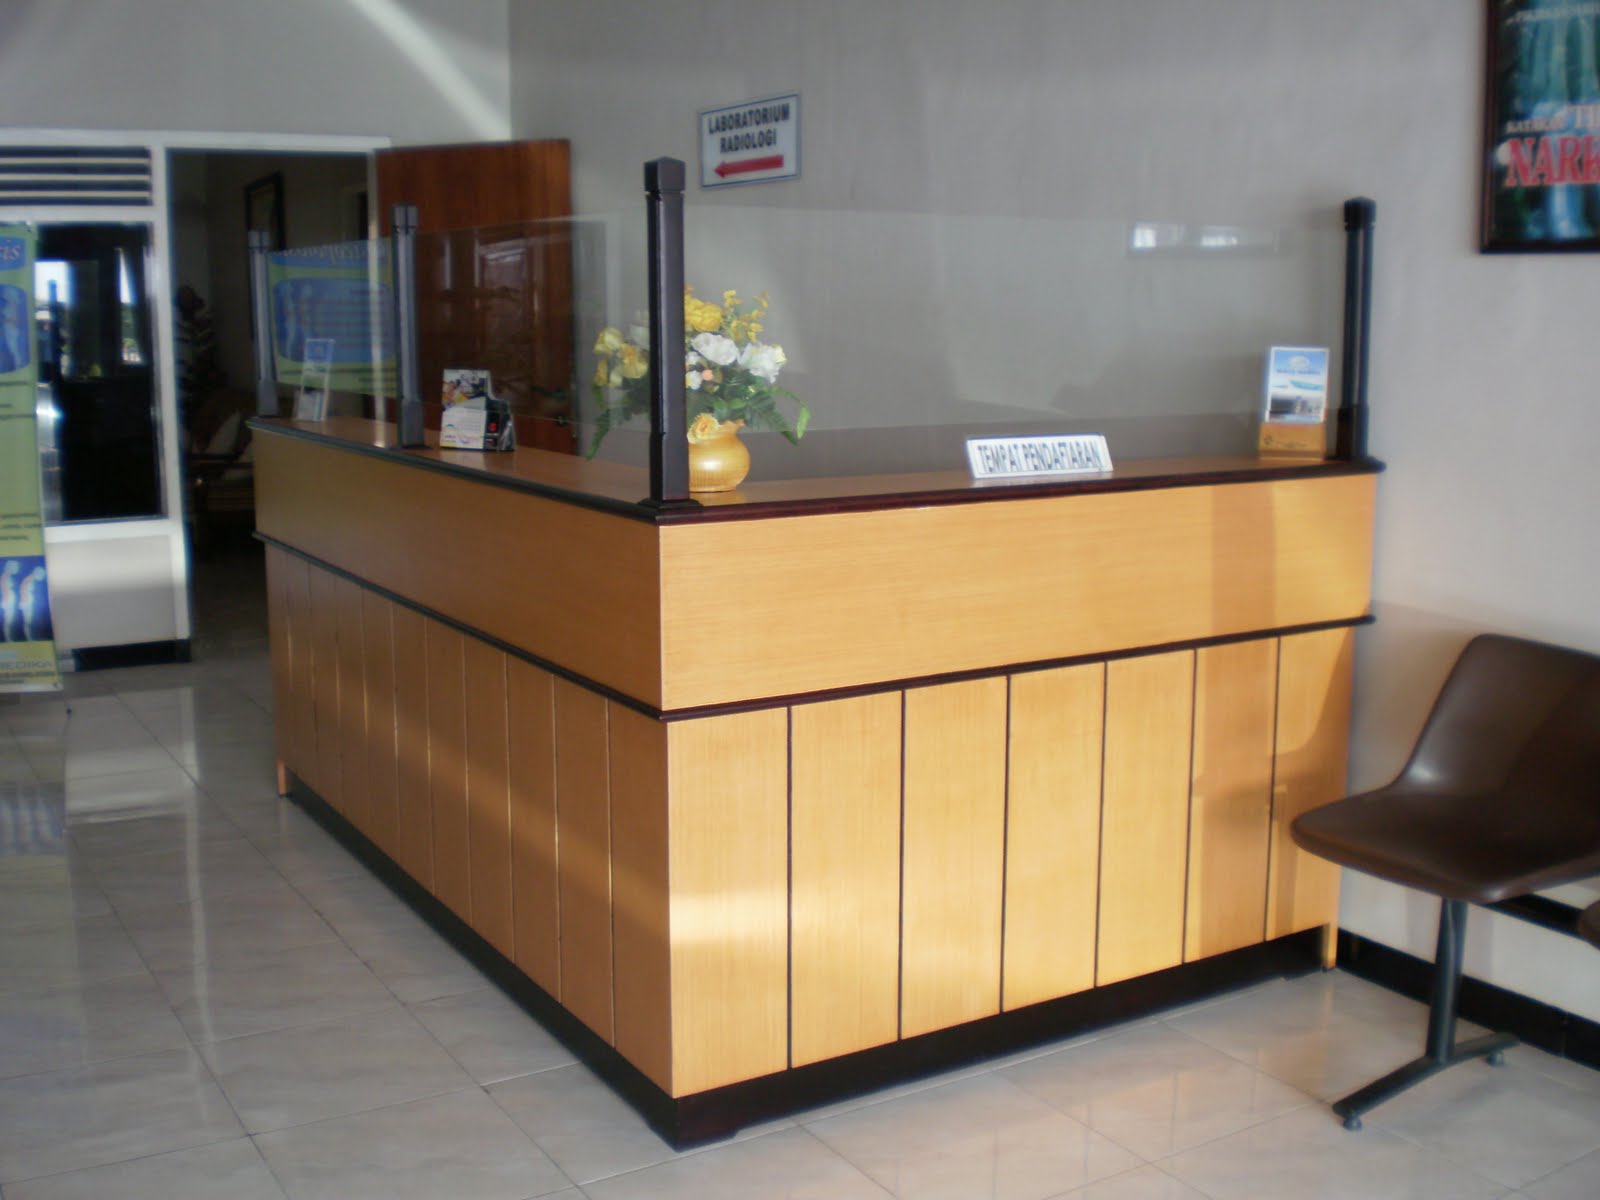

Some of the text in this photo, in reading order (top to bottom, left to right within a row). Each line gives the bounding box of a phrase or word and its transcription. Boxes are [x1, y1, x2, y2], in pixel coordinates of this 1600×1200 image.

[709, 103, 789, 134] LABORATORIUM
[720, 128, 777, 153] RADIOLOGI
[977, 441, 1103, 473] TEMPAT PENDAFTARAN
